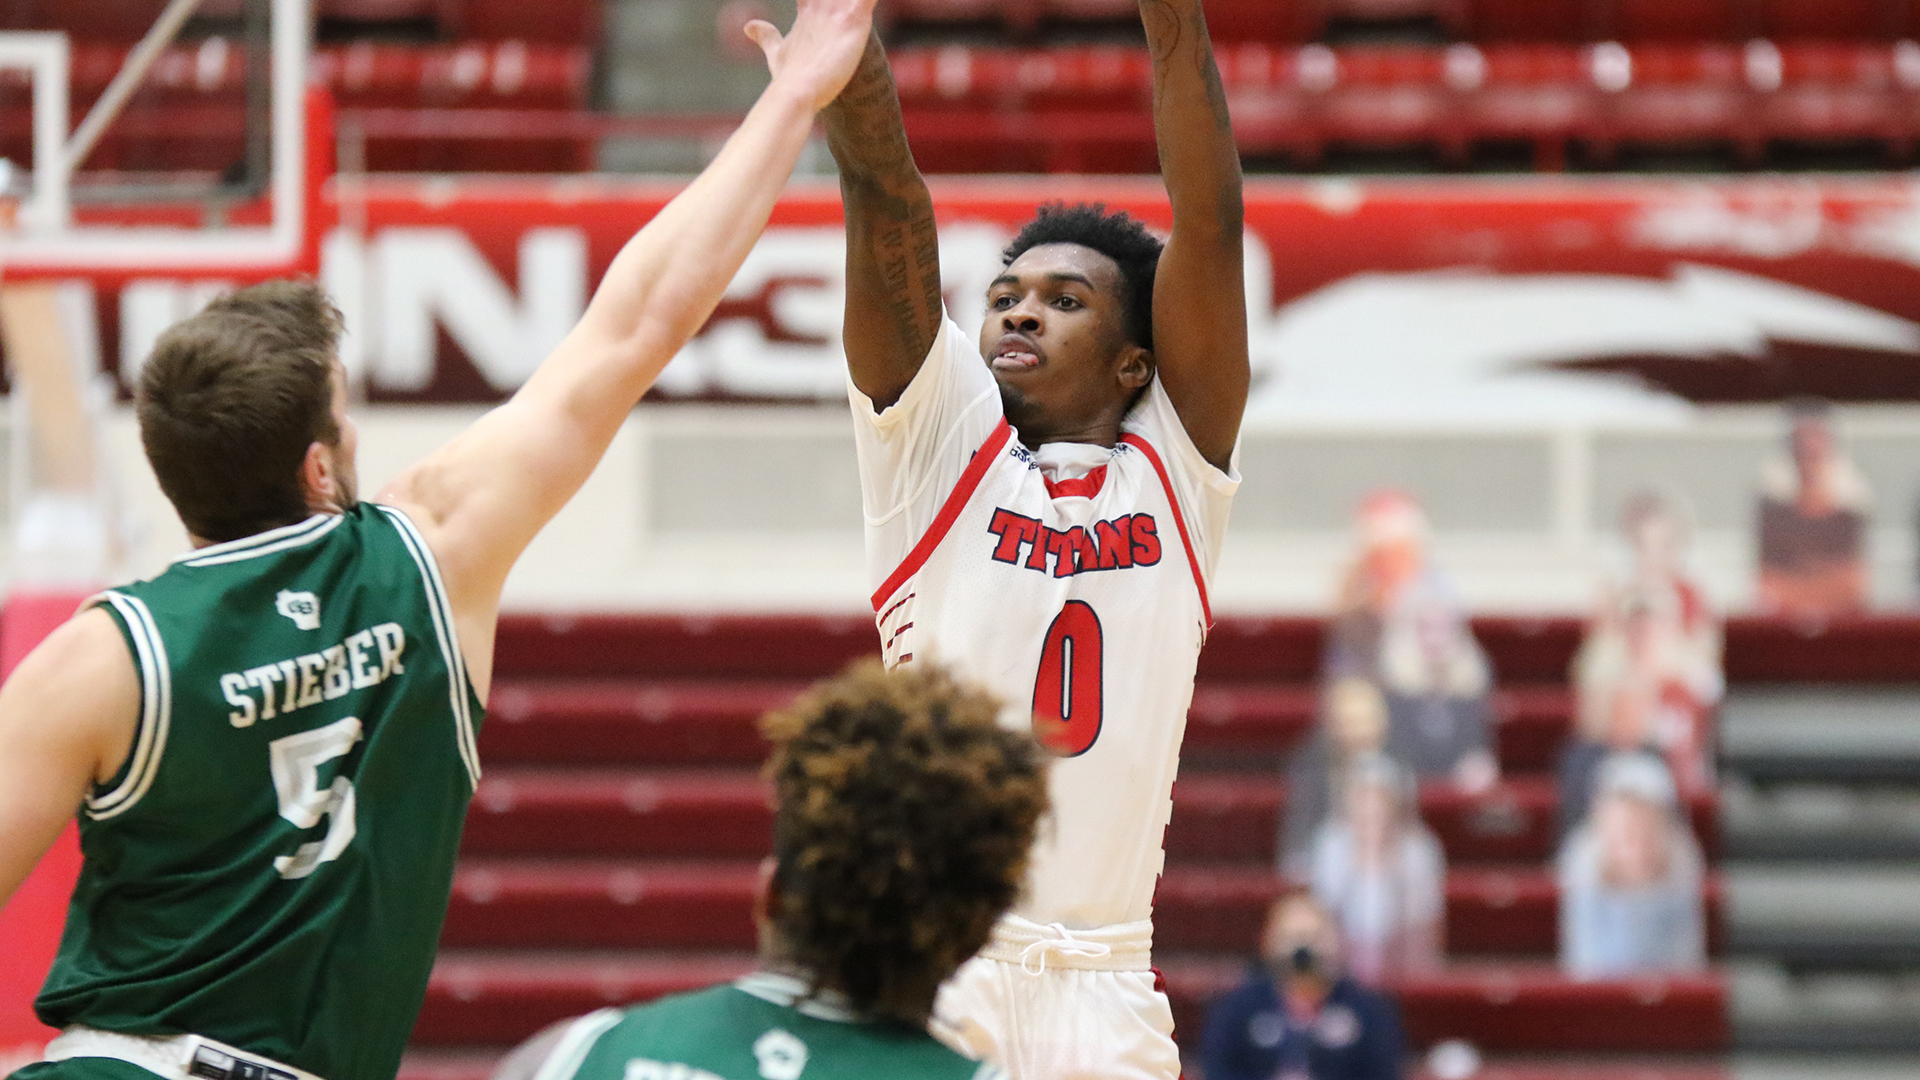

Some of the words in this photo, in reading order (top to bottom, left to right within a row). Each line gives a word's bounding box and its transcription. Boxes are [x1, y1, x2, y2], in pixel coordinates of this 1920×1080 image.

[987, 506, 1162, 579] TITANS
[219, 622, 406, 729] STIEBER
[1031, 599, 1104, 758] 0
[269, 716, 364, 880] 5
